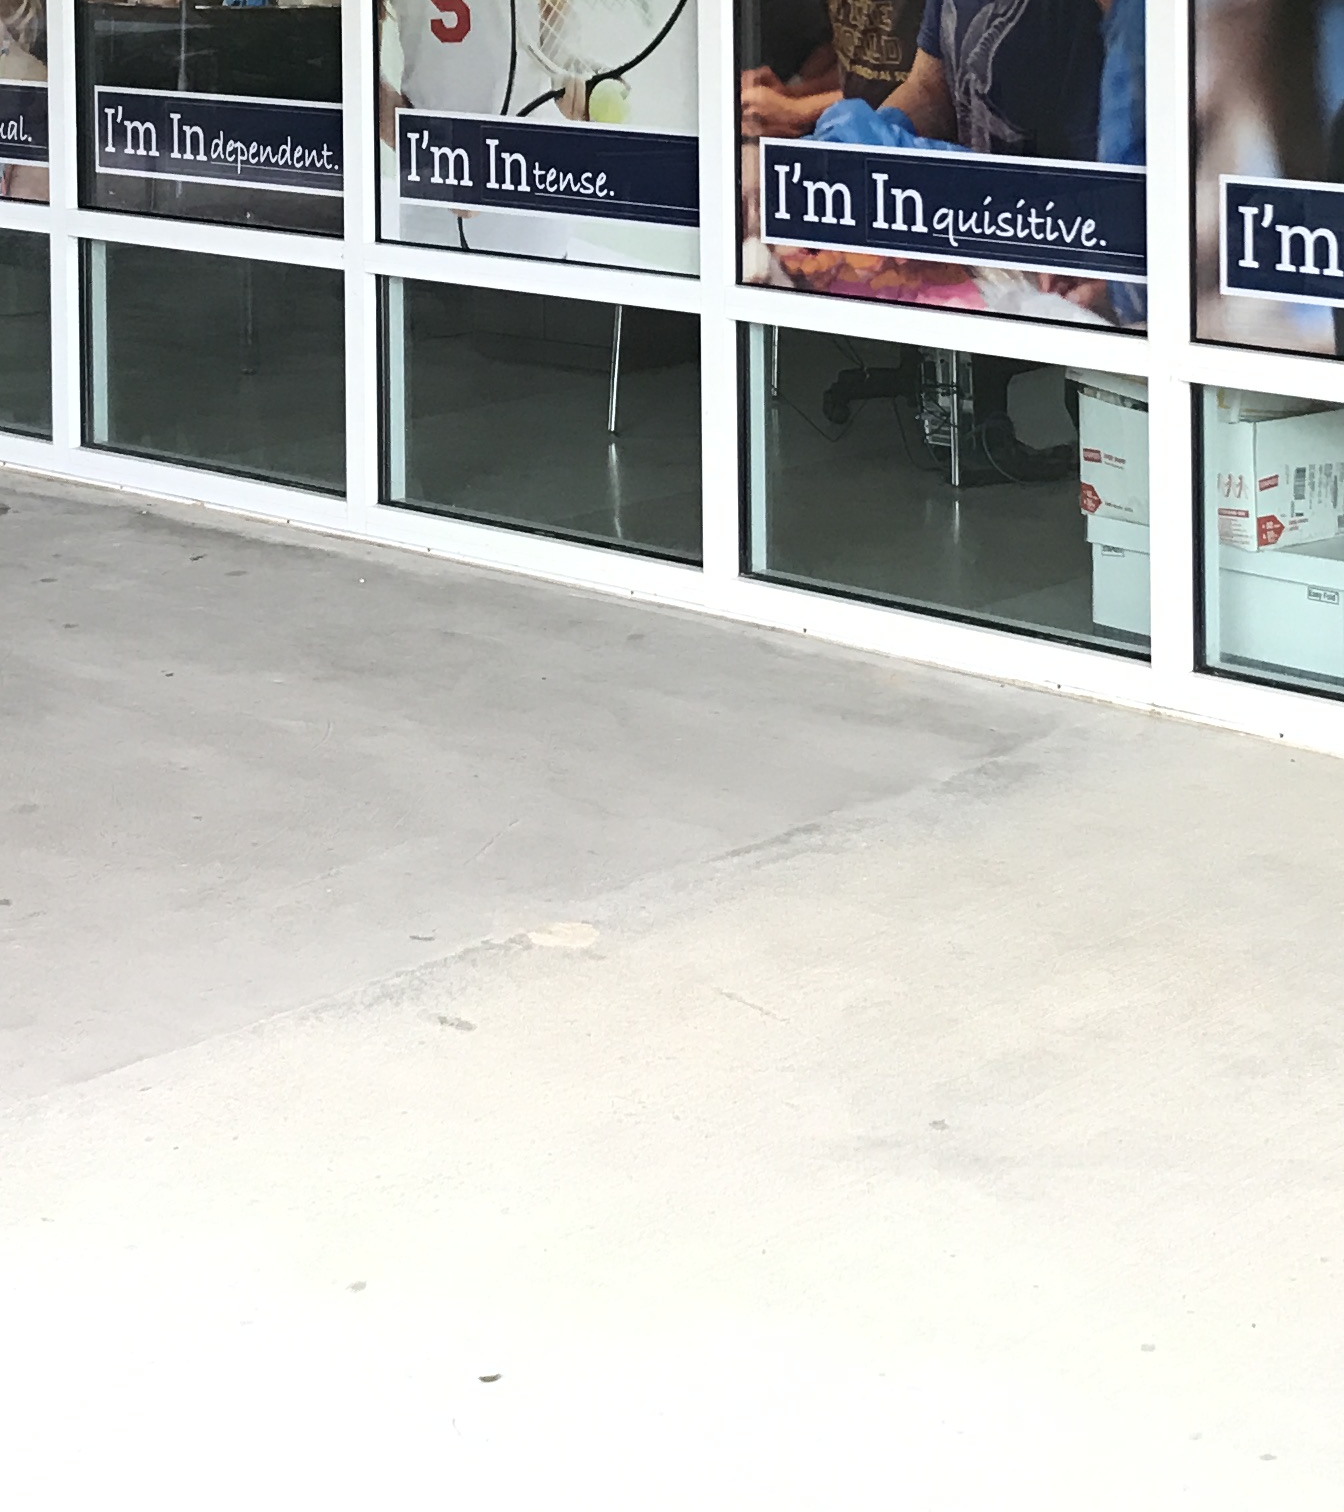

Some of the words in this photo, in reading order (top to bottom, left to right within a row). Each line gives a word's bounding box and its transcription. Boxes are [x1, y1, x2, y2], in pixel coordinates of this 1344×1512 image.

[103, 105, 160, 157] I'm
[406, 130, 474, 187] I'm
[773, 162, 856, 227] I'm
[1237, 203, 1344, 278] I'm
